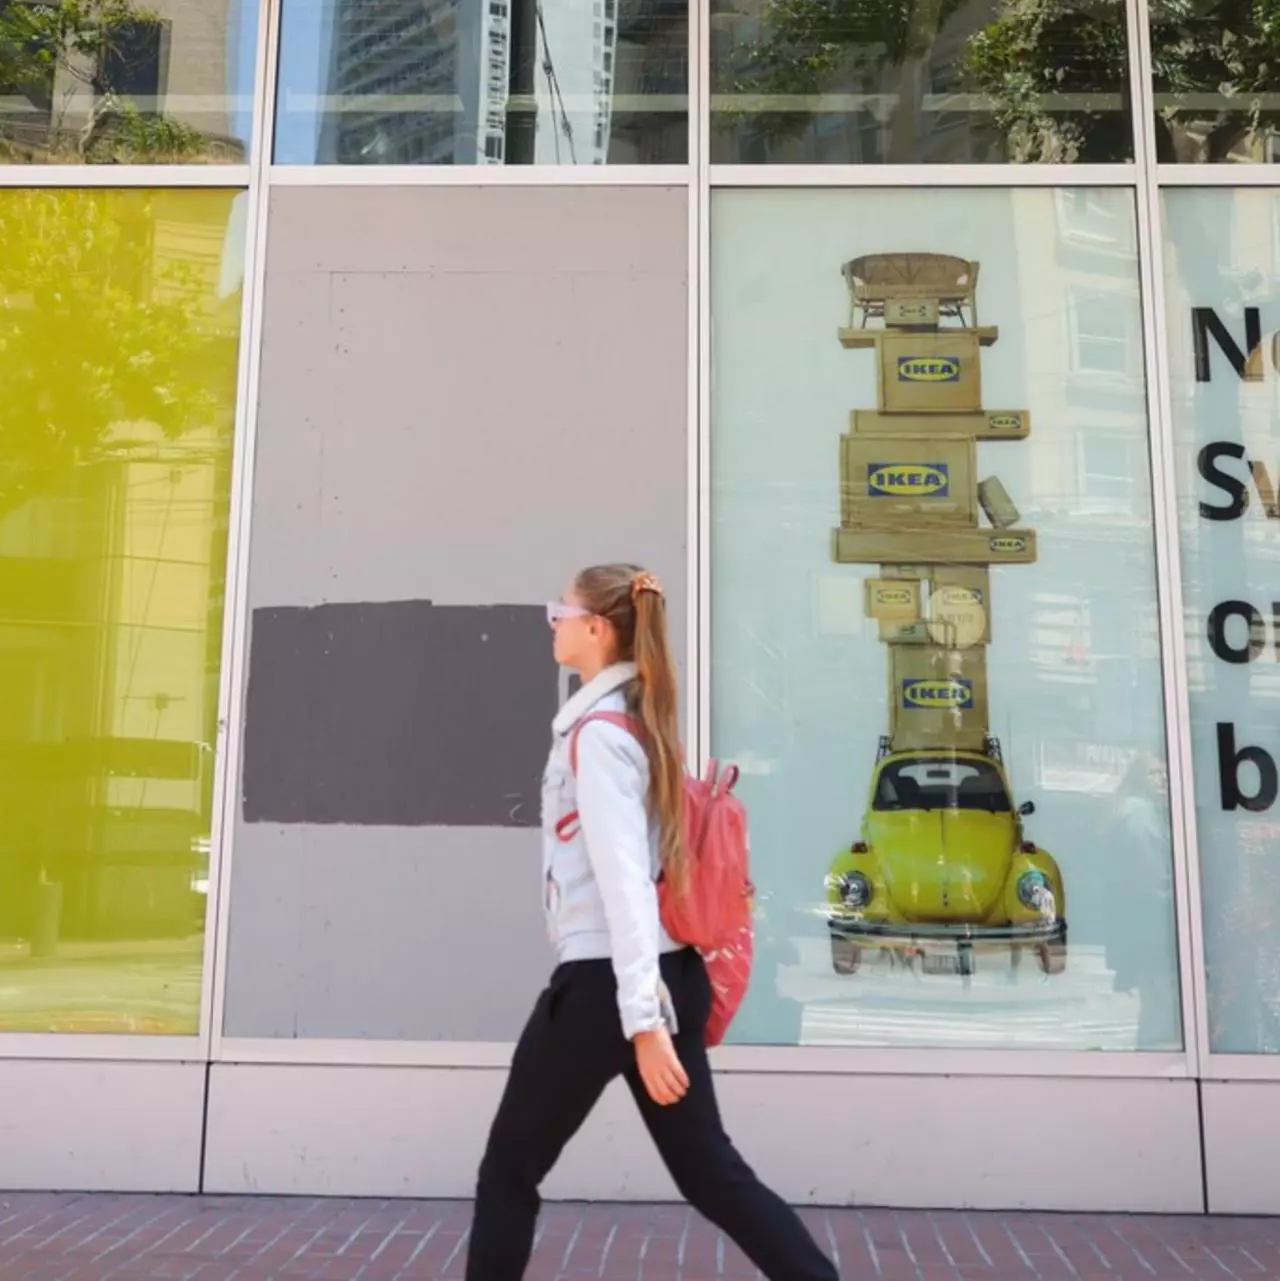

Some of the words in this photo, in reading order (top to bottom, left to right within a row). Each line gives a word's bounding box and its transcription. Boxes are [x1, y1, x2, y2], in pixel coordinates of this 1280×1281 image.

[904, 364, 953, 373] IKEA
[876, 473, 941, 486] IKEA
[911, 688, 965, 699] IKEA
